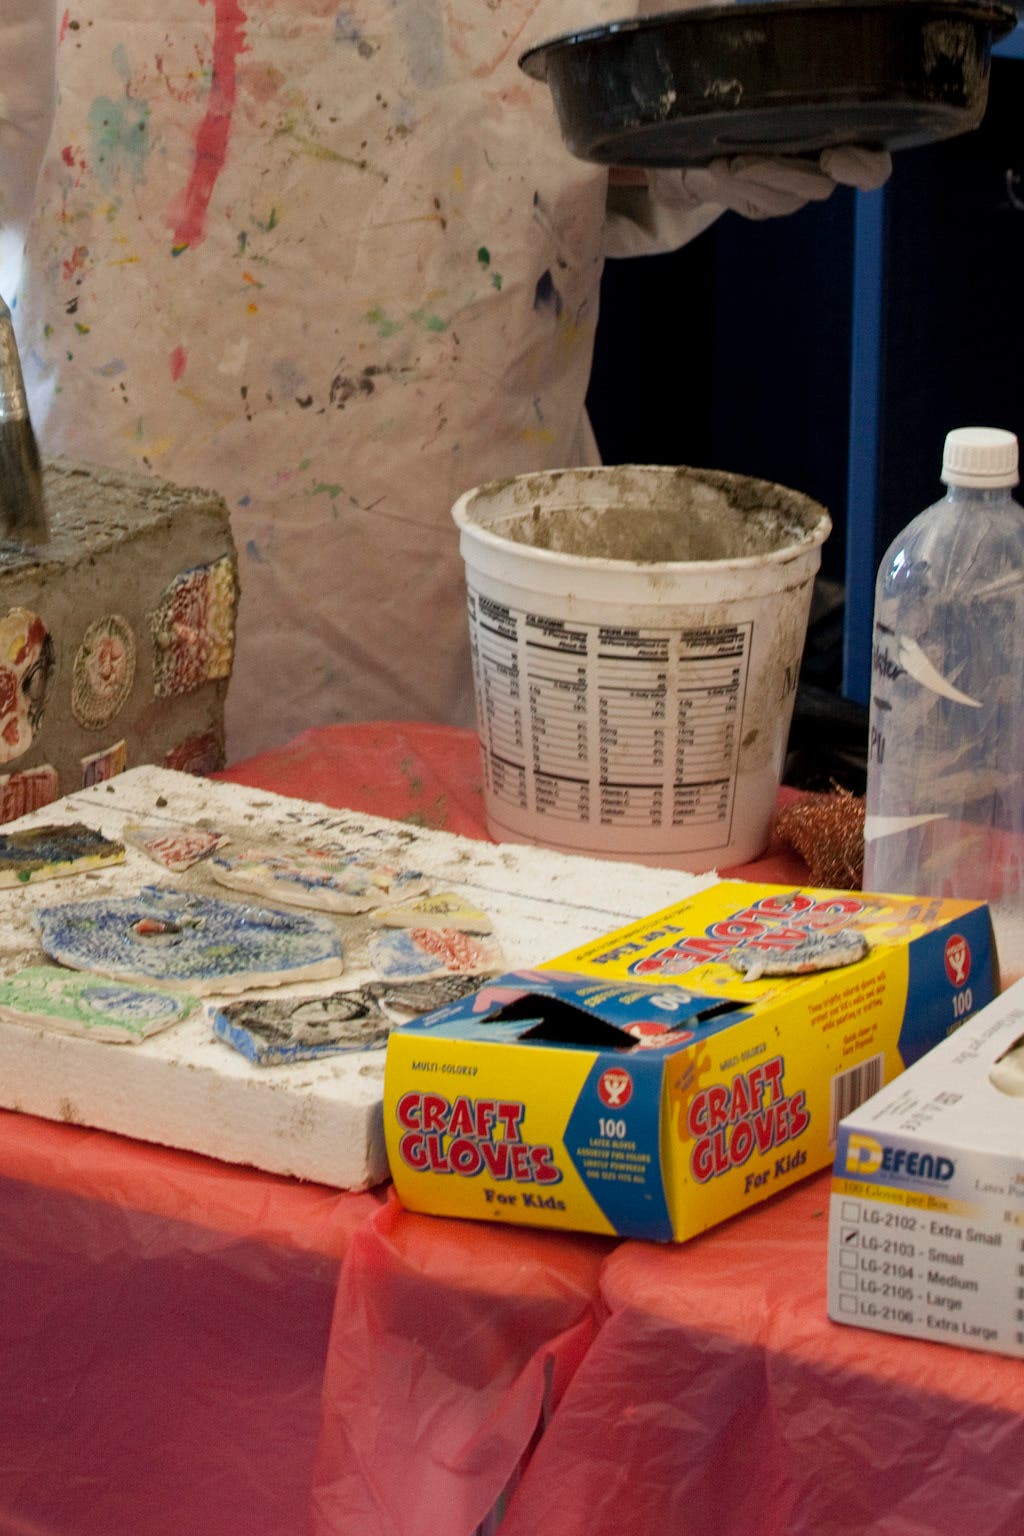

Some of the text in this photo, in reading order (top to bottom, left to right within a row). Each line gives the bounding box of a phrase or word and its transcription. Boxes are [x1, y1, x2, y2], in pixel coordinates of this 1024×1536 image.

[952, 987, 973, 1018] 100
[687, 1055, 784, 1138] CRAFT
[396, 1090, 526, 1142] CRAFT
[599, 1117, 626, 1139] 100
[690, 1090, 811, 1184] GLOVES
[399, 1133, 564, 1185] GLOVES
[744, 1149, 808, 1194] For Kids
[484, 1188, 567, 1211] For Kids
[843, 1181, 863, 1194] 100
[866, 1185, 903, 1200] Gloves
[905, 1193, 924, 1208] per
[863, 1208, 917, 1231] LG-2102
[930, 1221, 962, 1240] Extra
[965, 1228, 1003, 1246] Small
[861, 1234, 915, 1258] LG-2103
[928, 1248, 965, 1266] Small
[861, 1257, 914, 1280] LG-2104
[927, 1270, 979, 1292] Medium
[860, 1279, 914, 1302] LG-2105
[926, 1291, 962, 1311] Large
[860, 1301, 914, 1324] LG-2106
[927, 1314, 959, 1333] Extra
[962, 1321, 998, 1341] Large
